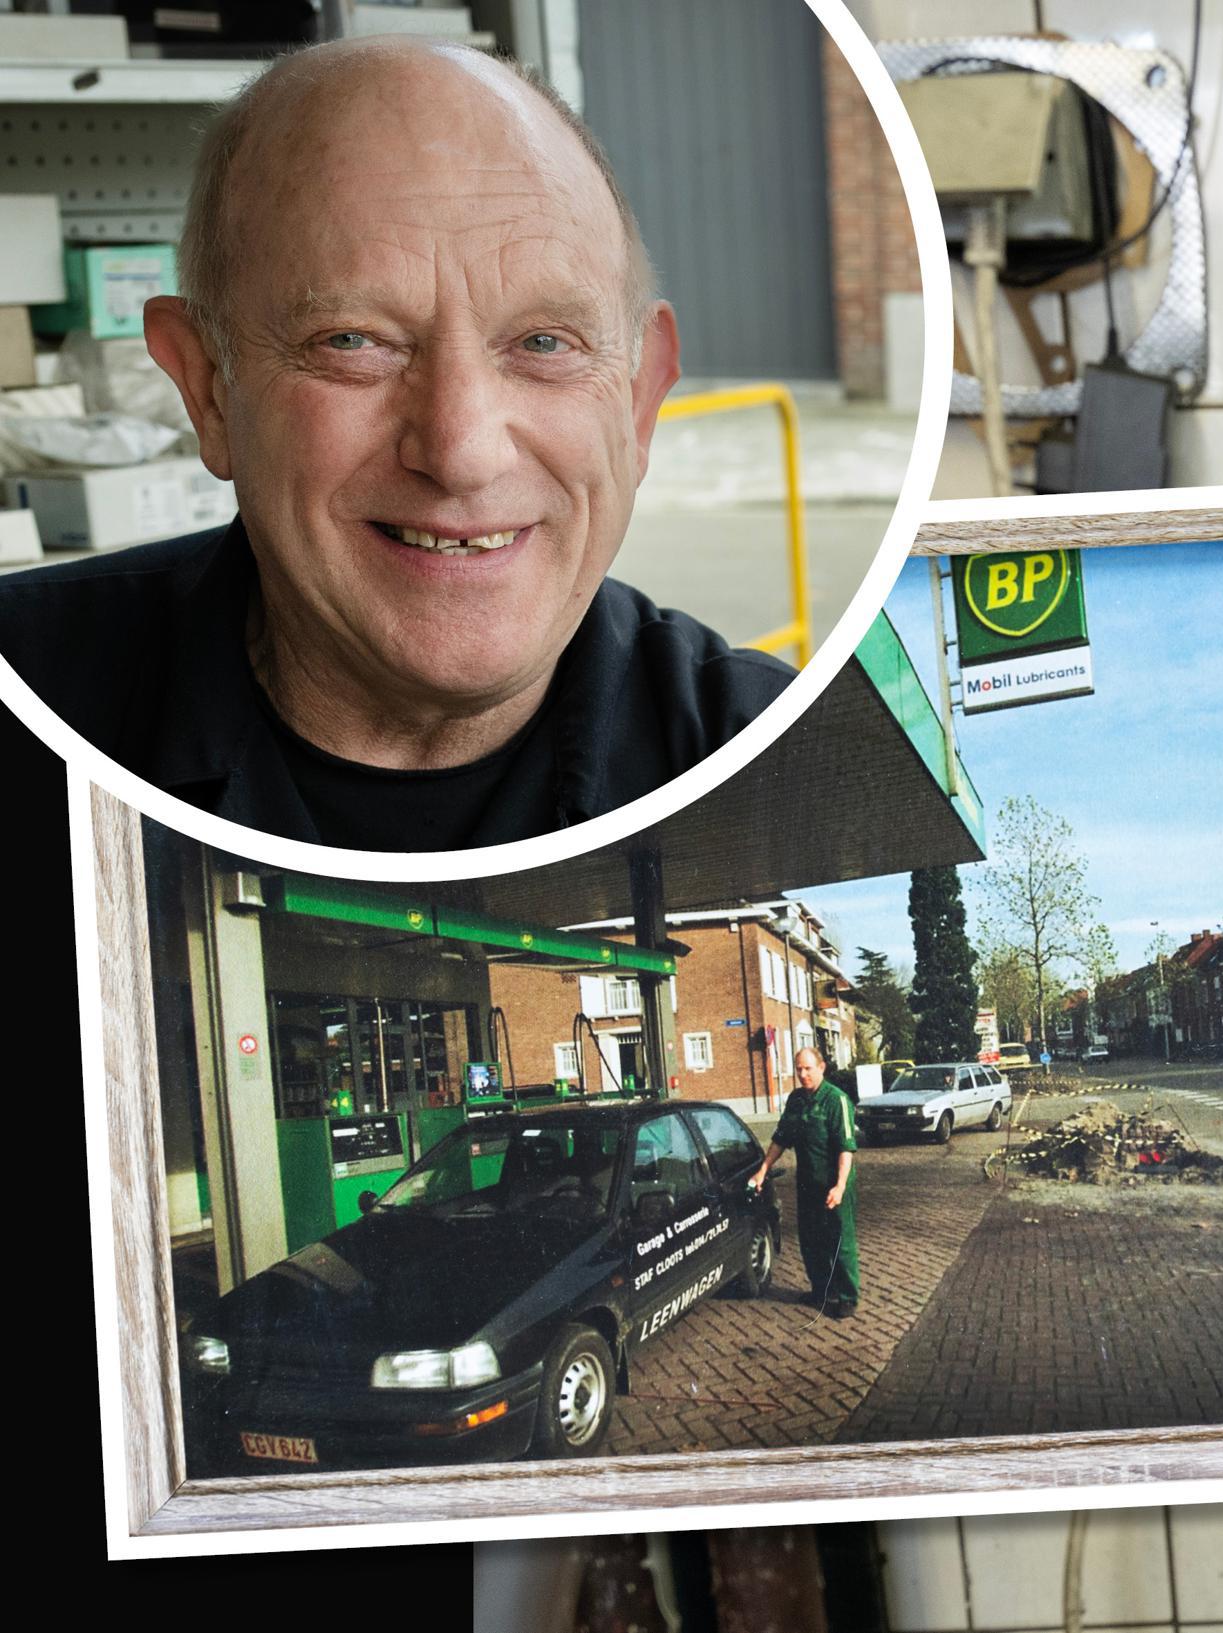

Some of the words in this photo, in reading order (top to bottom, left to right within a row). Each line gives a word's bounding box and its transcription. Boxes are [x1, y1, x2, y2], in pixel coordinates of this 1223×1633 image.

[985, 553, 1054, 611] BP
[967, 674, 1013, 694] Mobil
[1016, 665, 1086, 686] Lubricants
[637, 1233, 665, 1257] Garage
[634, 1268, 654, 1291] STAF
[656, 1248, 684, 1275] CLOOTS
[639, 1263, 724, 1343] LEENWAGEN
